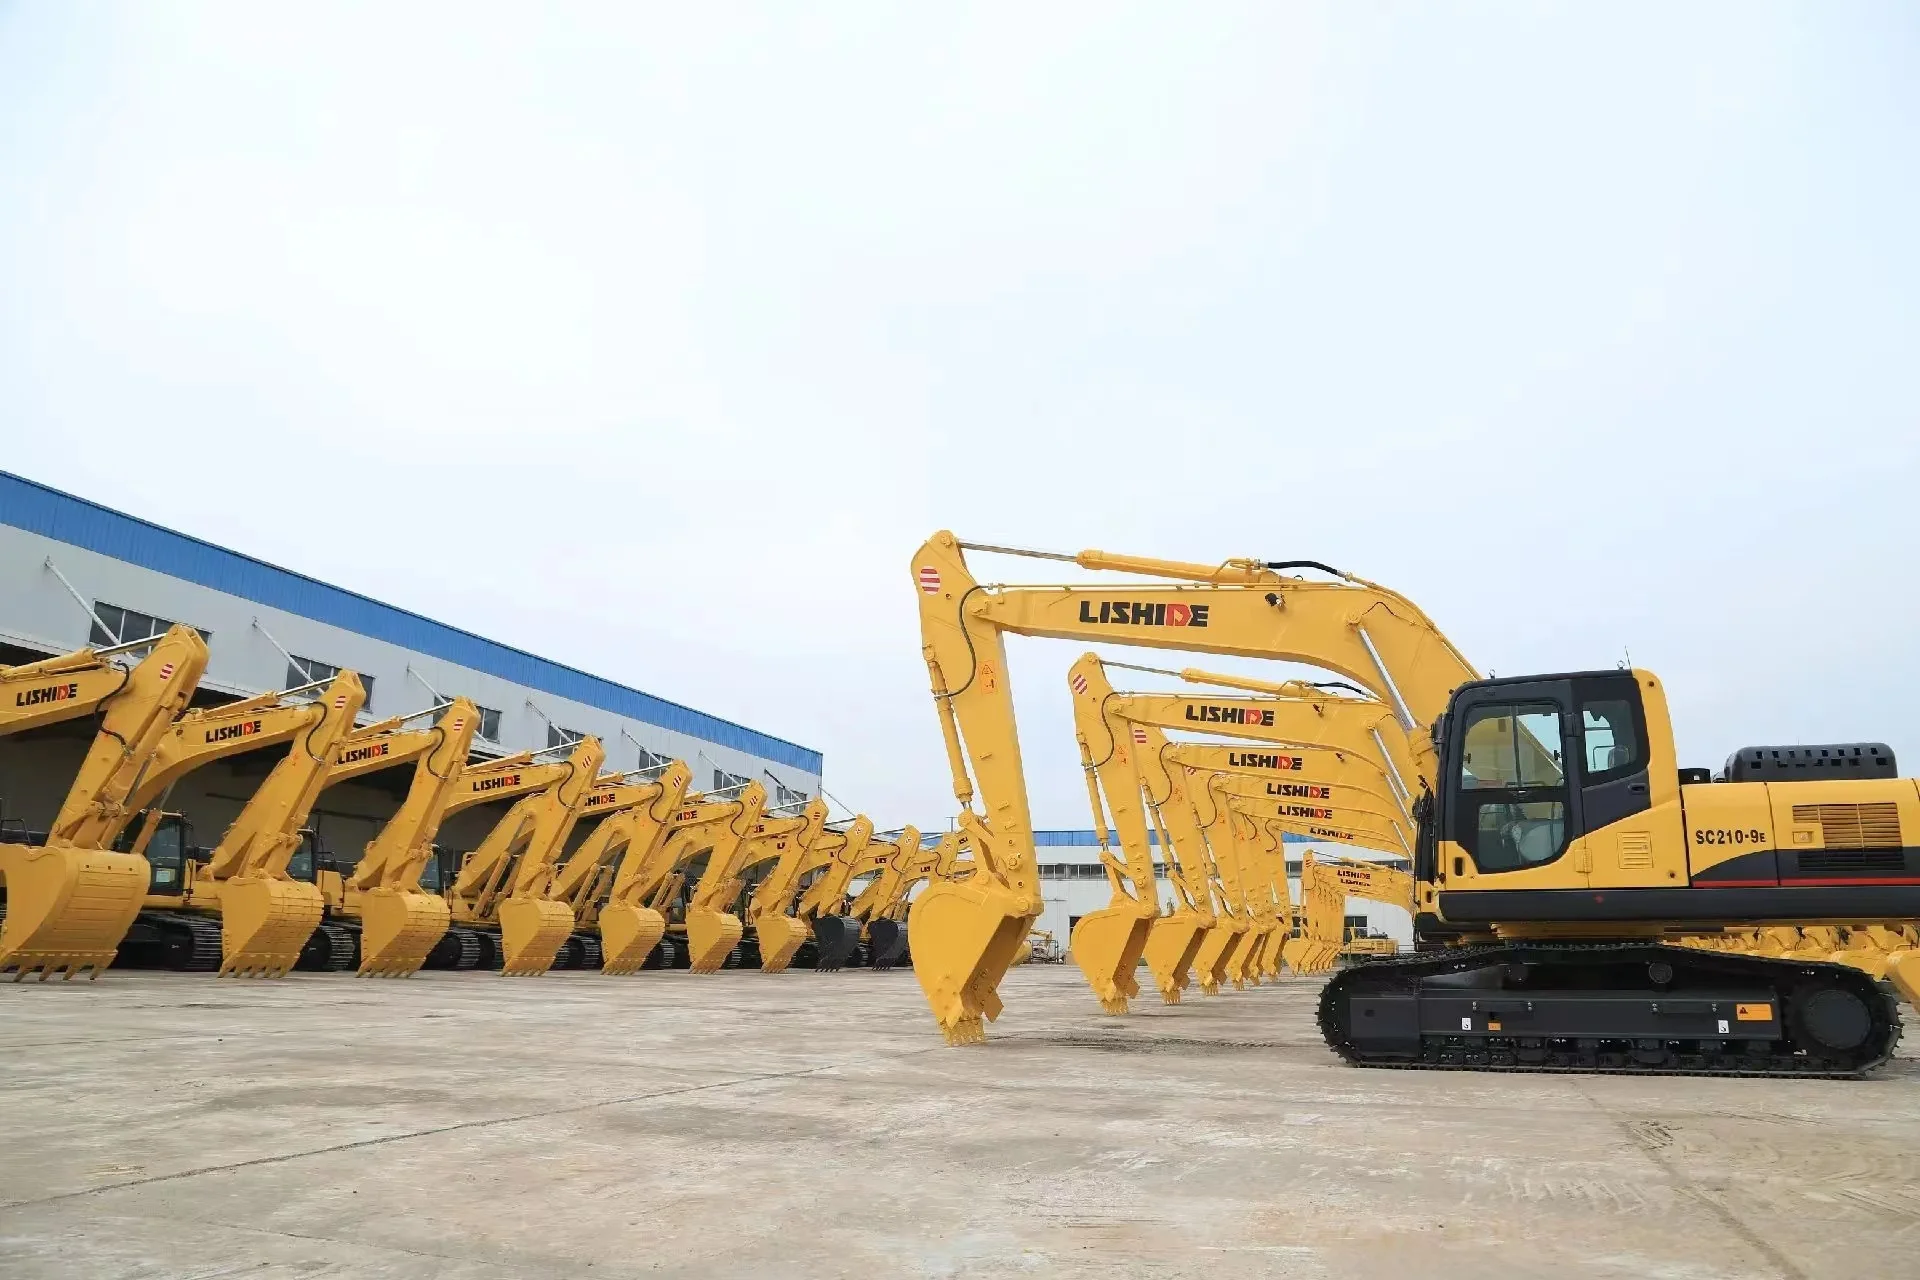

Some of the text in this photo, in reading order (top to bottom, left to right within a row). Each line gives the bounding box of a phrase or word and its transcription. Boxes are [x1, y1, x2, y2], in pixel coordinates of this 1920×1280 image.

[1079, 601, 1209, 627] LISHIDE
[16, 683, 78, 707] LISHIDE
[1186, 705, 1275, 727] LISHIDE
[205, 720, 262, 743] LISHIDE
[338, 743, 389, 764] LISHIDE
[1229, 753, 1303, 771] LISHIDE
[472, 774, 521, 792] LISHIDE
[1266, 782, 1330, 799] LISHIDE
[1278, 805, 1333, 820] LISHIDE
[1695, 829, 1767, 845] SC210-9E
[1337, 869, 1371, 880] LISHIDE
